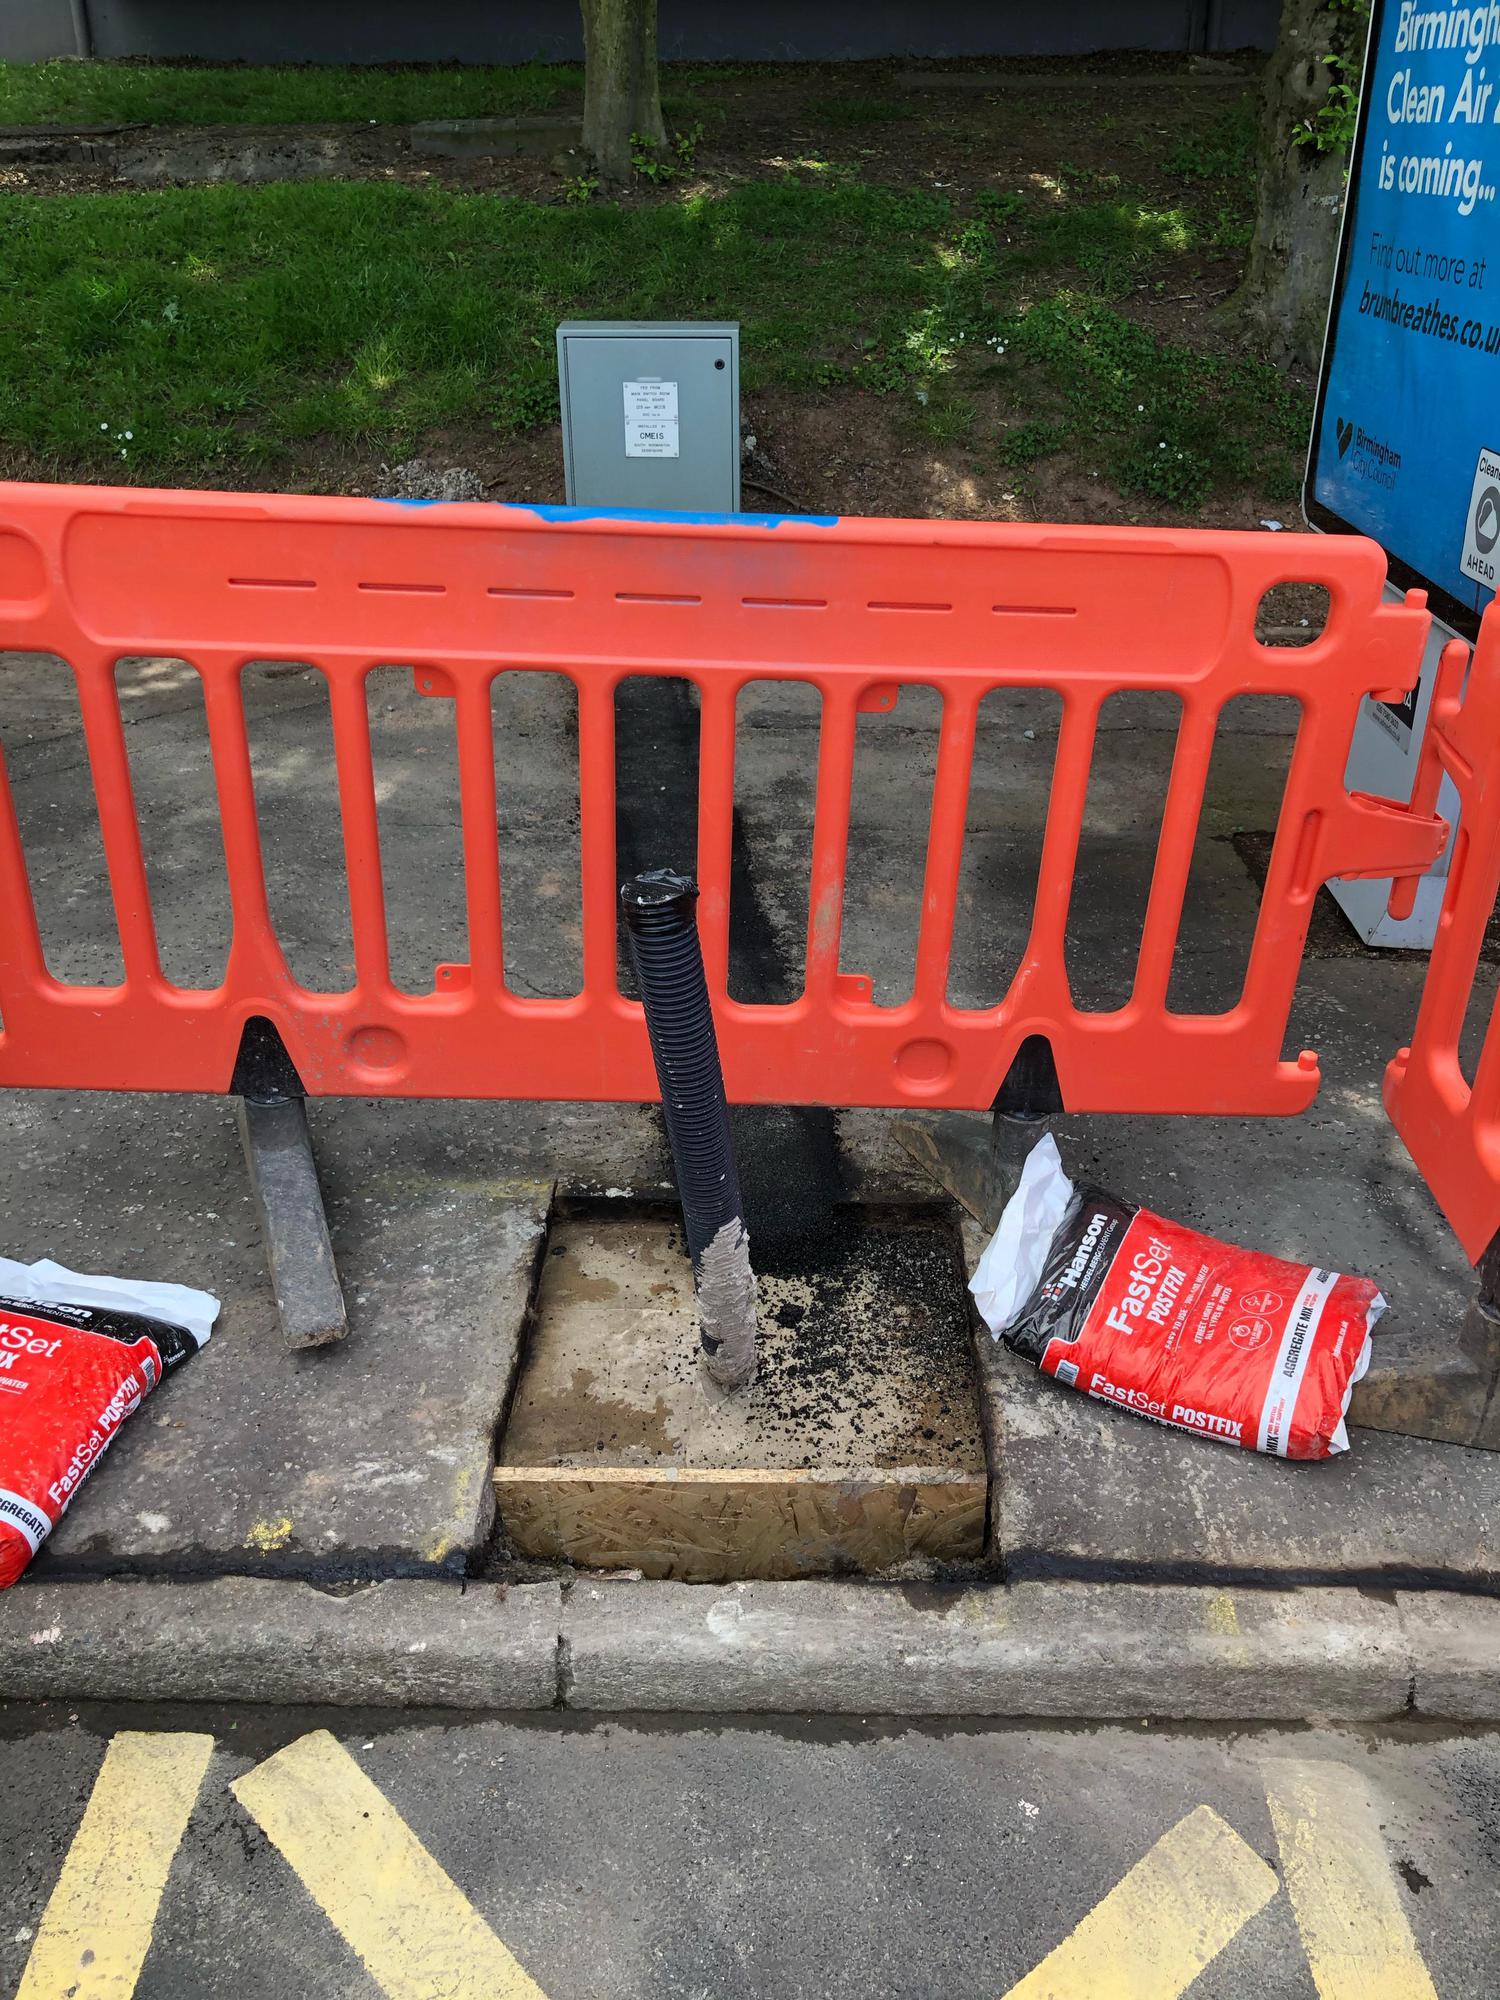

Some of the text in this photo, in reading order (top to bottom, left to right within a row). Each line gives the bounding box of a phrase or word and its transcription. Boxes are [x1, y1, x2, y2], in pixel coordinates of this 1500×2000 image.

[1387, 68, 1445, 124] Clean
[1448, 66, 1493, 124] Air
[1378, 139, 1496, 216] is coming...
[1370, 232, 1486, 289] Find out more at
[640, 432, 664, 440] CMEIS
[1356, 427, 1401, 470] Birmingham
[1467, 553, 1494, 580] AHEAD
[1064, 1213, 1108, 1288] Hanson
[1105, 1236, 1171, 1335] FastSet
[1146, 1265, 1187, 1326] POSTFIX
[1282, 1322, 1309, 1378] AGGREGATE
[1299, 1306, 1314, 1323] MIX
[1090, 1373, 1166, 1417] FastSet
[1172, 1404, 1243, 1439] POSTFIX
[48, 1429, 104, 1504] FastSet
